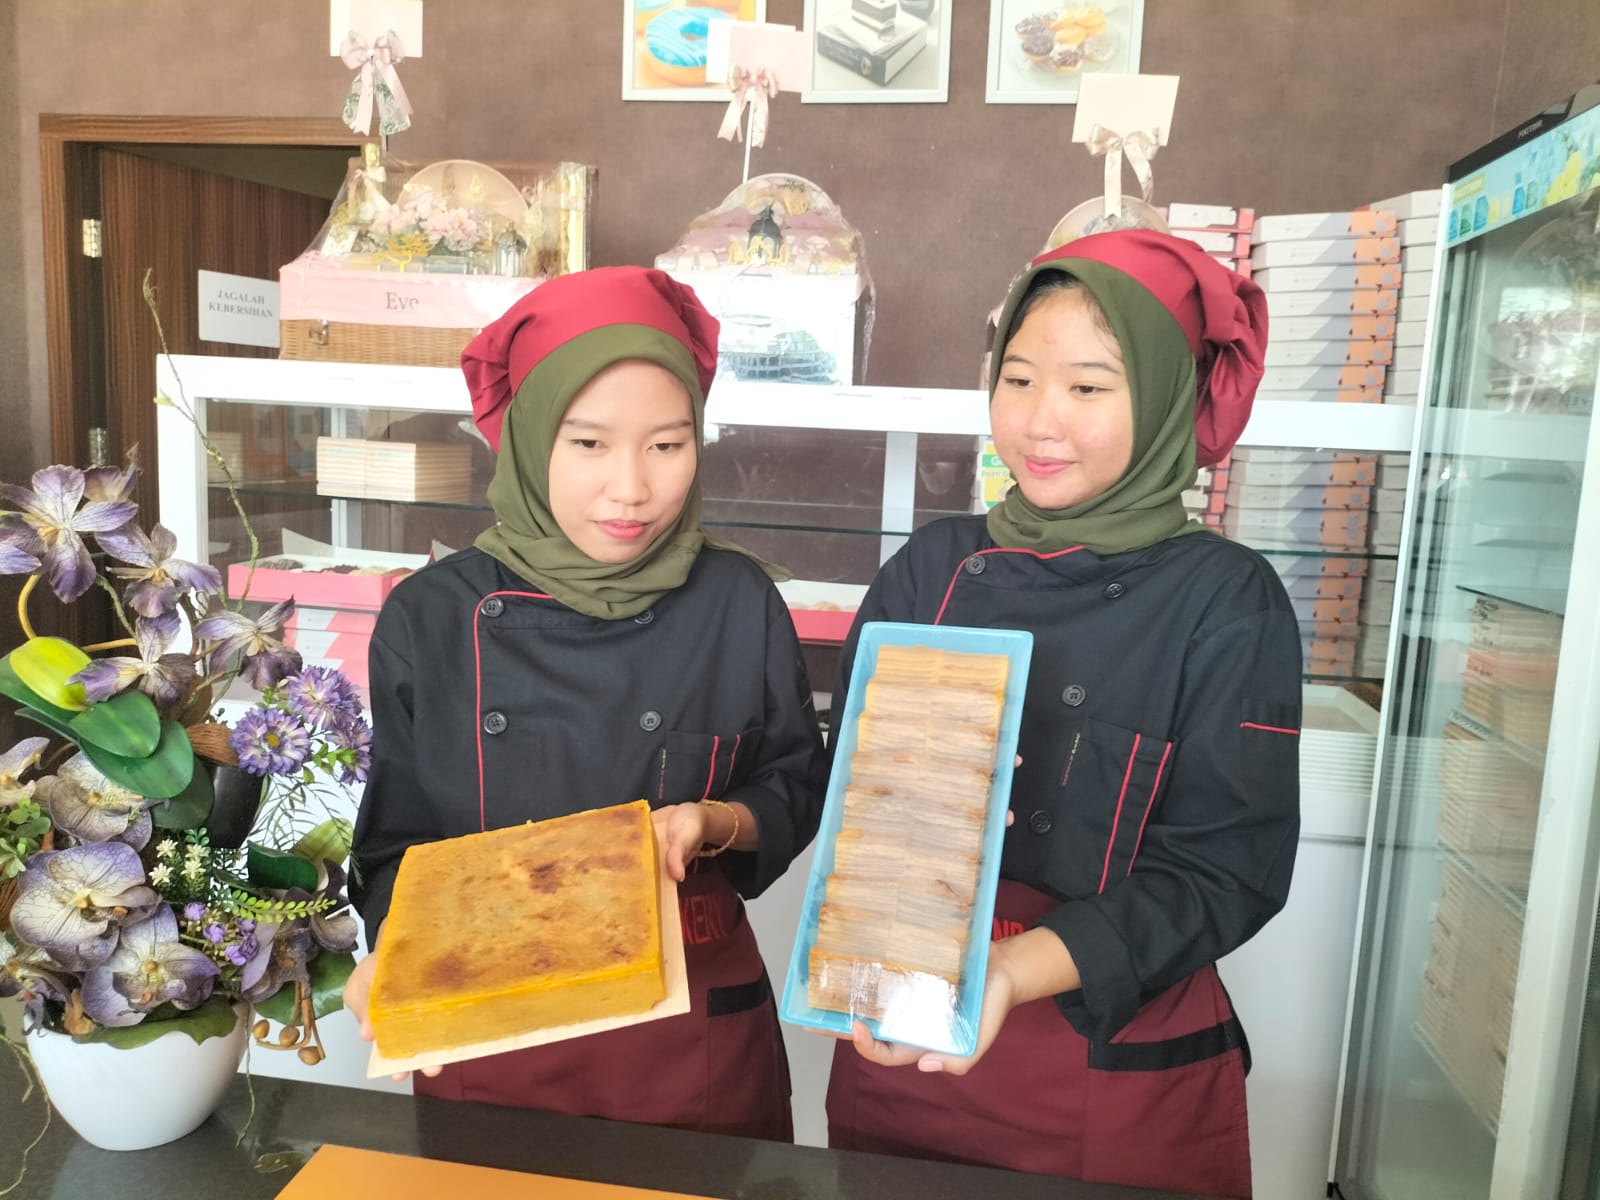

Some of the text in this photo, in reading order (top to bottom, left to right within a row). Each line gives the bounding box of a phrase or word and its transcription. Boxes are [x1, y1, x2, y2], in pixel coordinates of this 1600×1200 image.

[217, 290, 265, 304] JAGALAH
[384, 291, 420, 310] Eve
[208, 301, 273, 318] KEBERSIHAN
